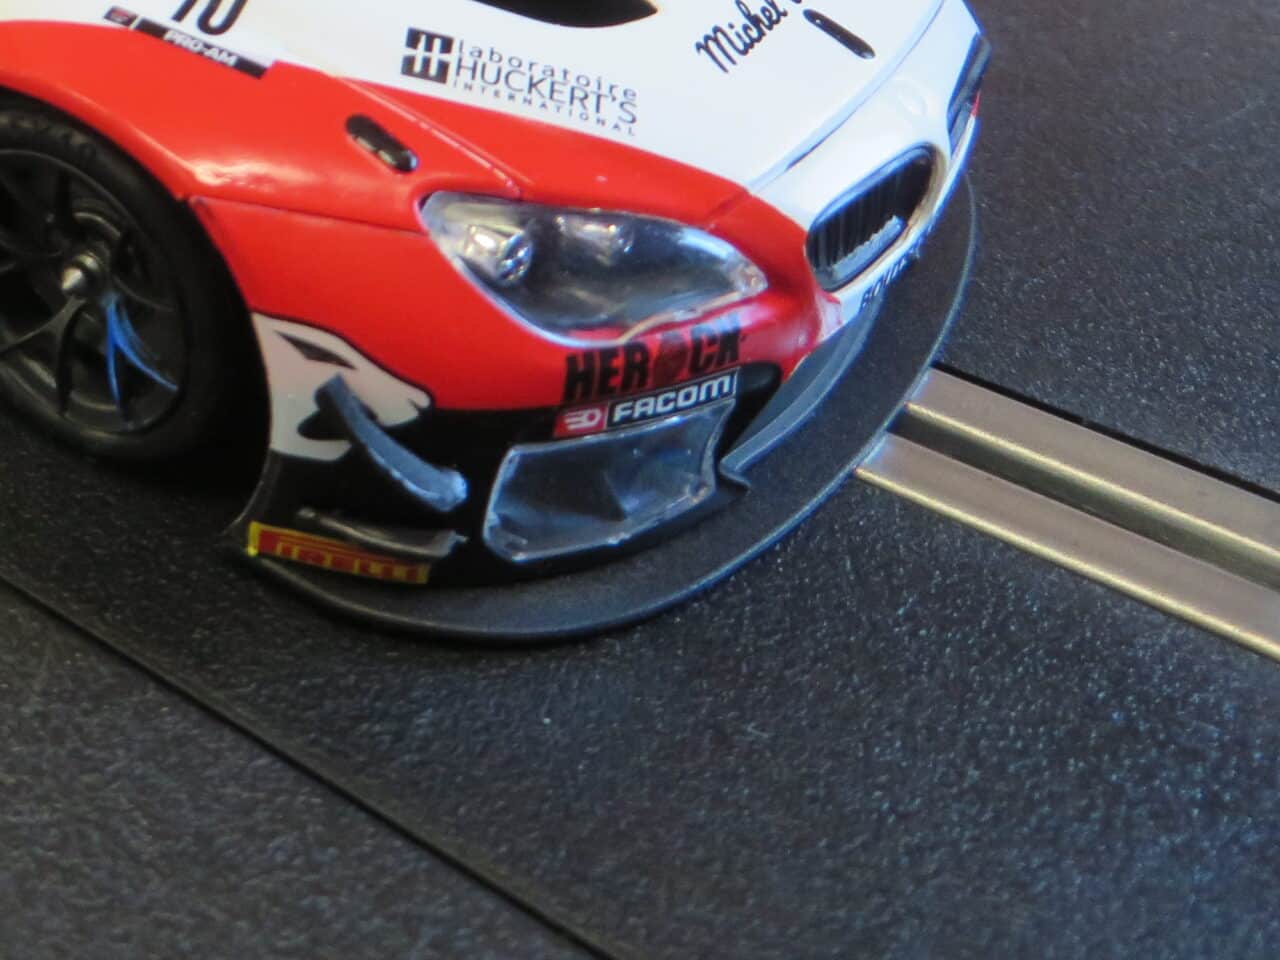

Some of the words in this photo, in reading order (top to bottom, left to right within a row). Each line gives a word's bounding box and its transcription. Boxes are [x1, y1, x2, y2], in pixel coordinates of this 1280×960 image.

[164, 30, 238, 66] PRO-AM
[458, 40, 638, 102] laboratoire
[452, 80, 636, 137] INTERNATIONAL
[456, 57, 638, 125] HUCKERT'S
[613, 375, 731, 423] FACOM
